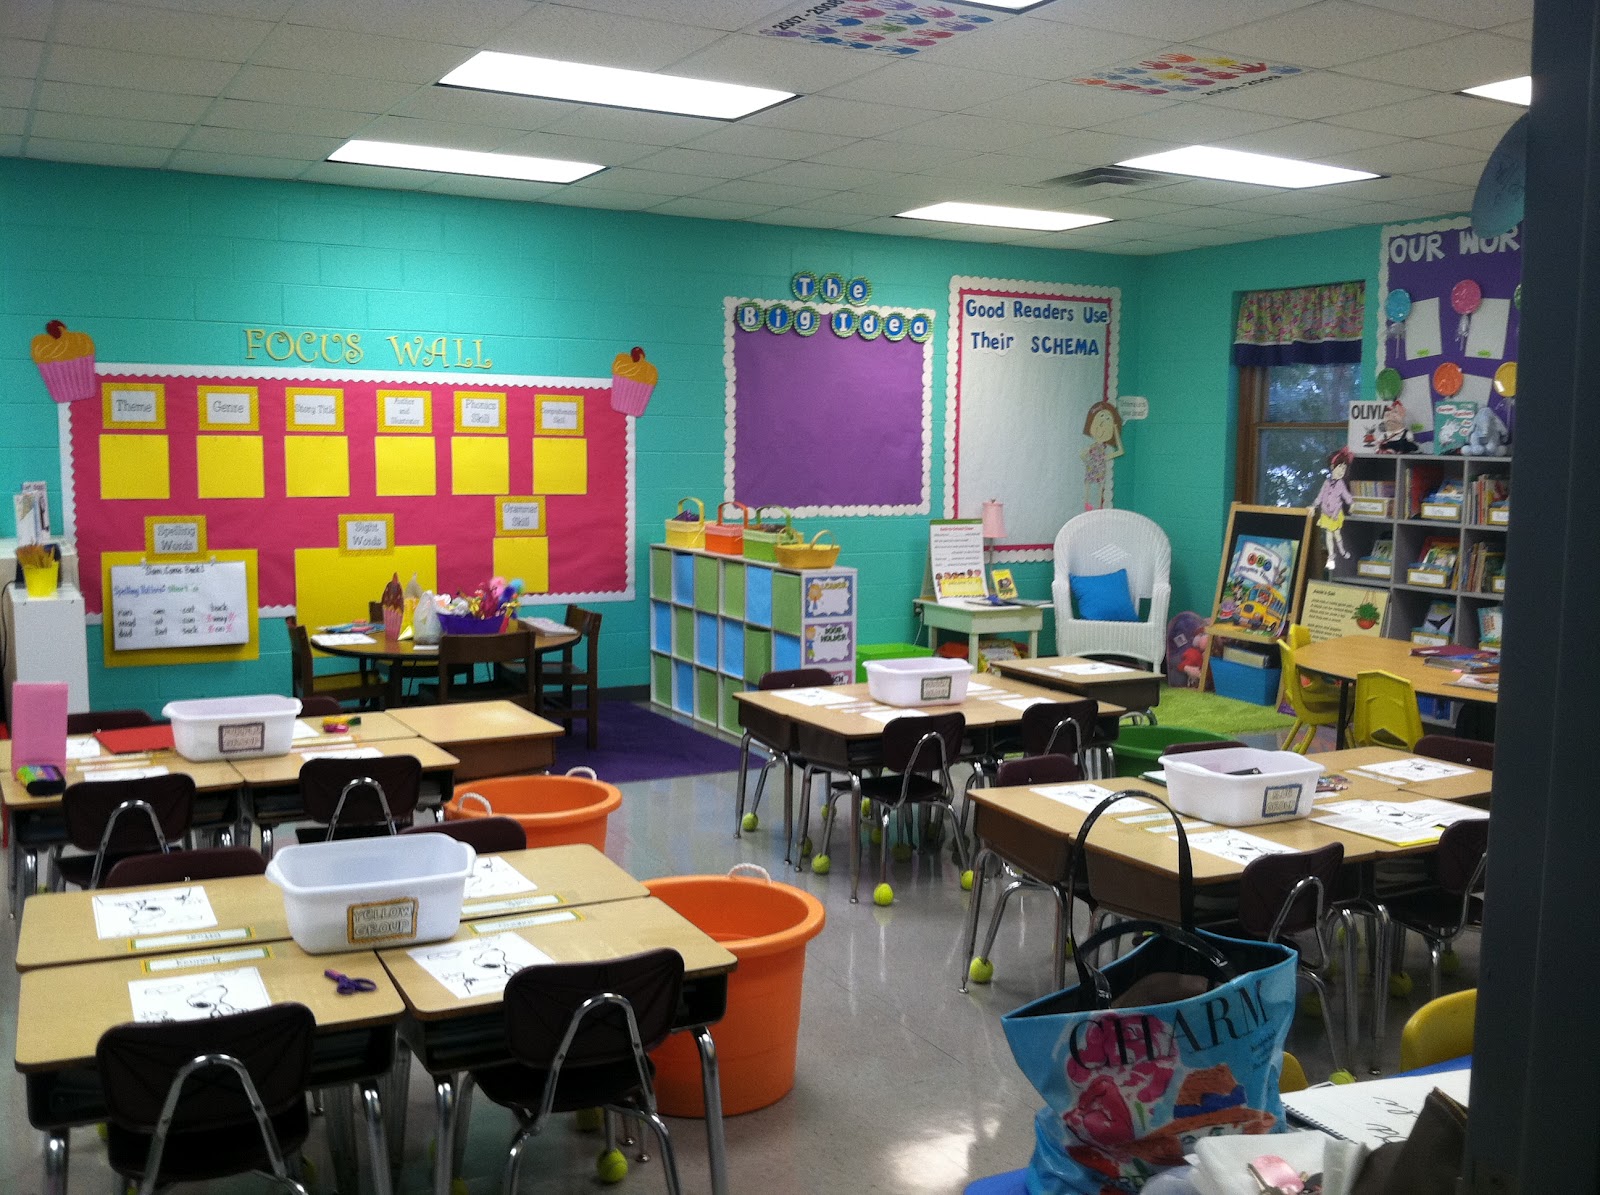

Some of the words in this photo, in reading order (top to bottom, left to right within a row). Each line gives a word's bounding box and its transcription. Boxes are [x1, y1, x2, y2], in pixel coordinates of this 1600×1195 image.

[1390, 234, 1445, 263] OUR
[966, 299, 1005, 318] Good
[1013, 300, 1074, 322] Readers
[1083, 306, 1108, 323] Use
[743, 306, 811, 330] Big
[839, 310, 926, 335] Idea
[243, 328, 364, 365] FOCUS
[386, 335, 493, 370] WALL
[971, 331, 1014, 350] Their
[1031, 336, 1100, 355] SCHEMA
[116, 399, 152, 413] Theme
[212, 400, 244, 413] Genre
[465, 399, 496, 410] Phonics
[471, 413, 490, 423] Skill
[157, 525, 196, 538] Spelling
[354, 522, 379, 533] Sight
[160, 540, 193, 551] Words
[352, 535, 382, 546] Words
[354, 905, 410, 921] YELLOW
[355, 920, 409, 936] GROUP
[1069, 979, 1268, 1070] CHARM
